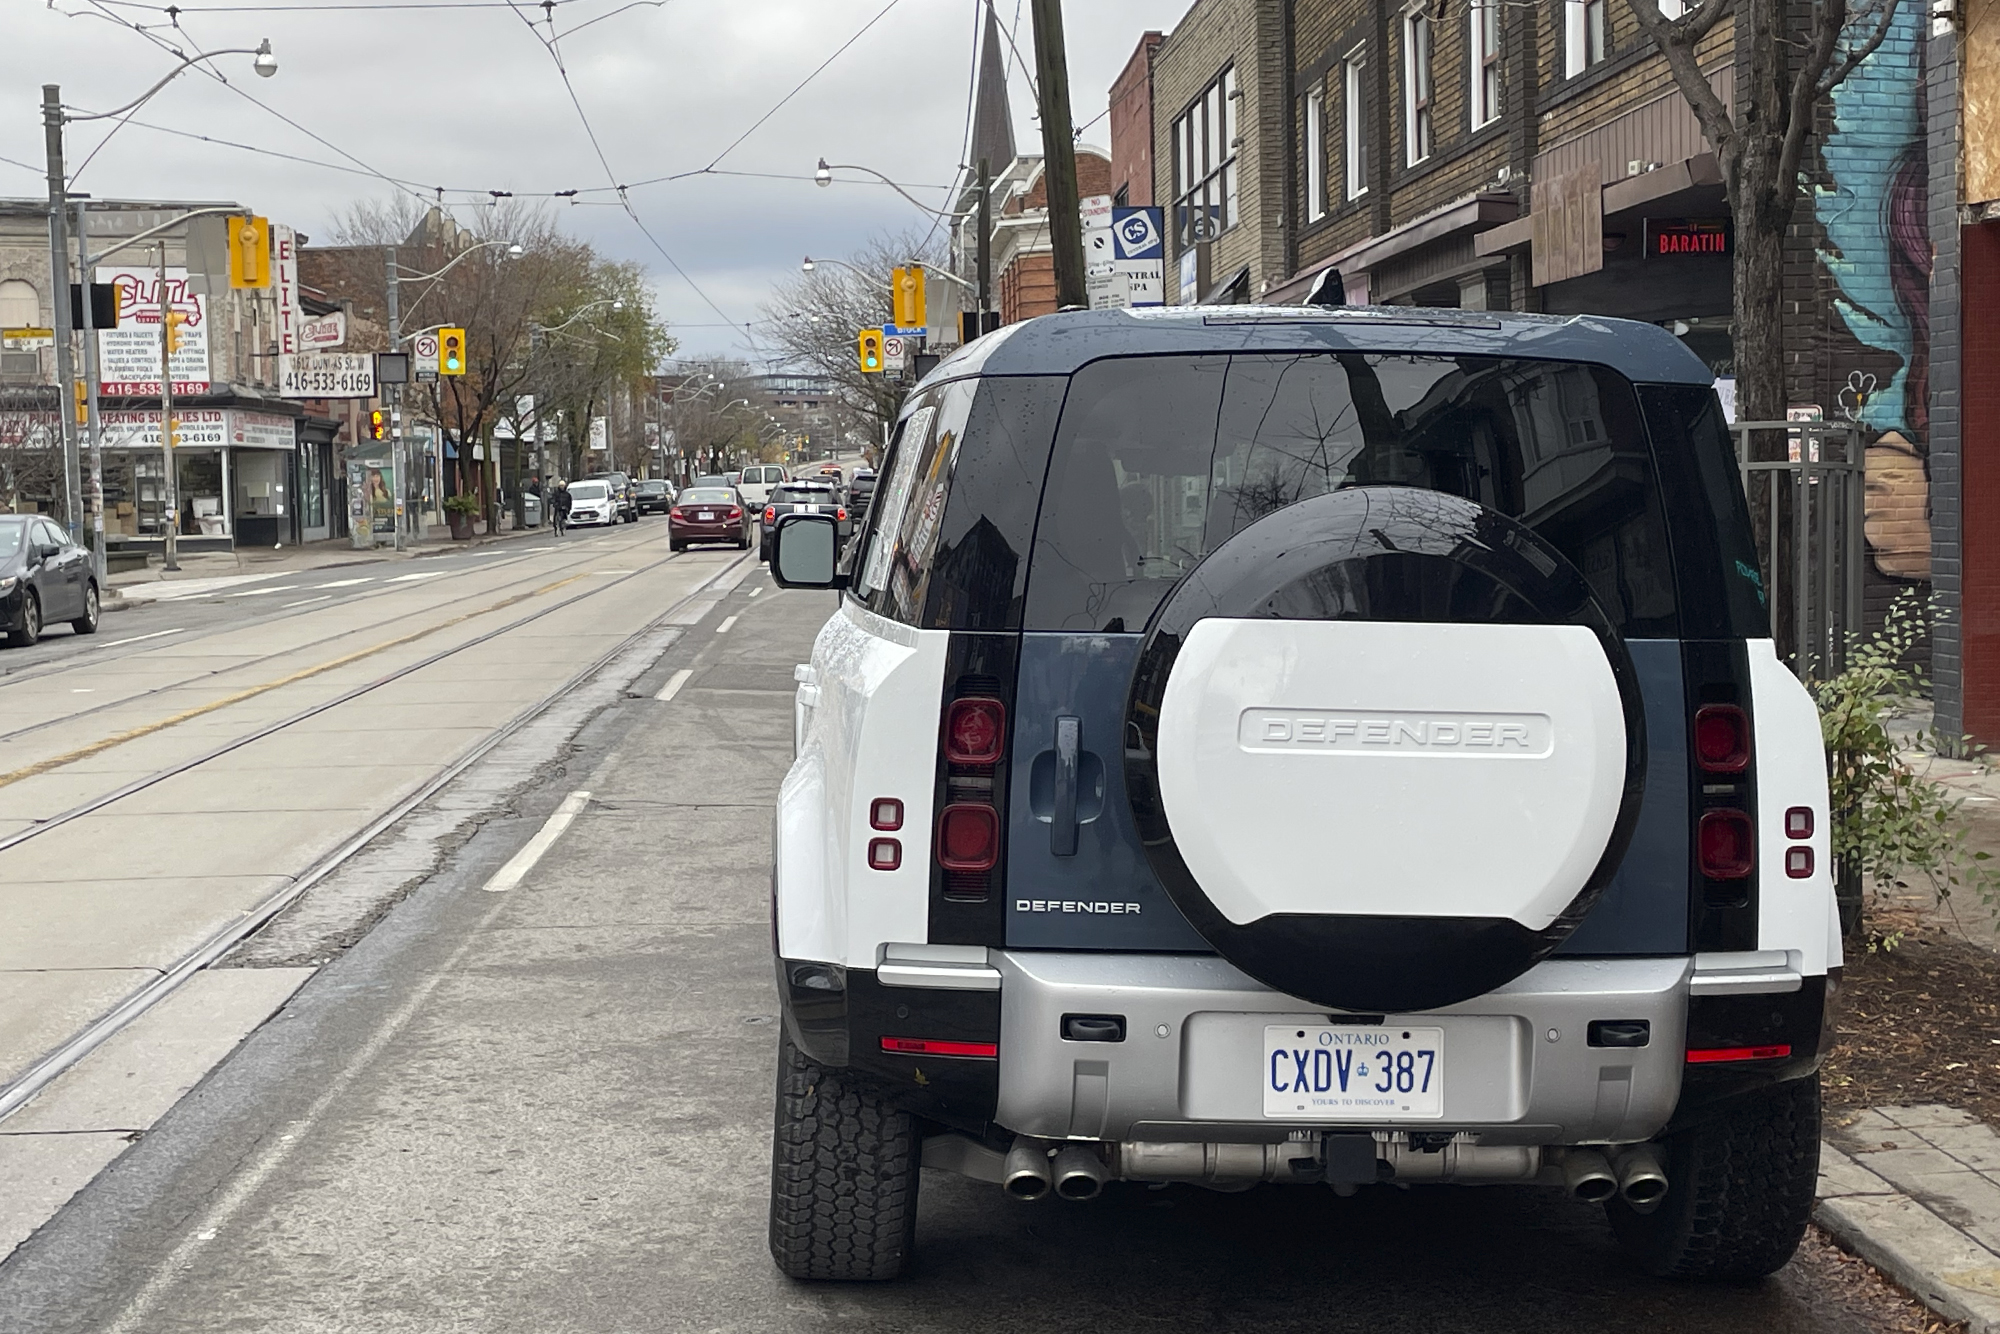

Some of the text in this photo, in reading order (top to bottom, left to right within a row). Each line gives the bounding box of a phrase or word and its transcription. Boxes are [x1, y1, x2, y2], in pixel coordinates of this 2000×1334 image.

[1091, 198, 1100, 206] NO
[1083, 206, 1110, 217] STANDING
[1124, 221, 1146, 241] CS
[1659, 232, 1725, 254] BARATIN
[1127, 271, 1161, 280] NTRAL
[279, 240, 293, 354] ELITE
[107, 383, 204, 395] 416-5336169
[286, 373, 371, 391] 416-533-6169
[99, 411, 145, 424] HEATING
[148, 411, 199, 423] SUPLIES
[202, 411, 224, 423] LTD.
[142, 433, 221, 443] 4163-6169
[1261, 717, 1530, 747] DEFENDER
[1016, 899, 1141, 914] DEFENDER
[1271, 1049, 1435, 1093] CXDV 387
[1311, 1098, 1395, 1106] YOURS TO DISCOVER
